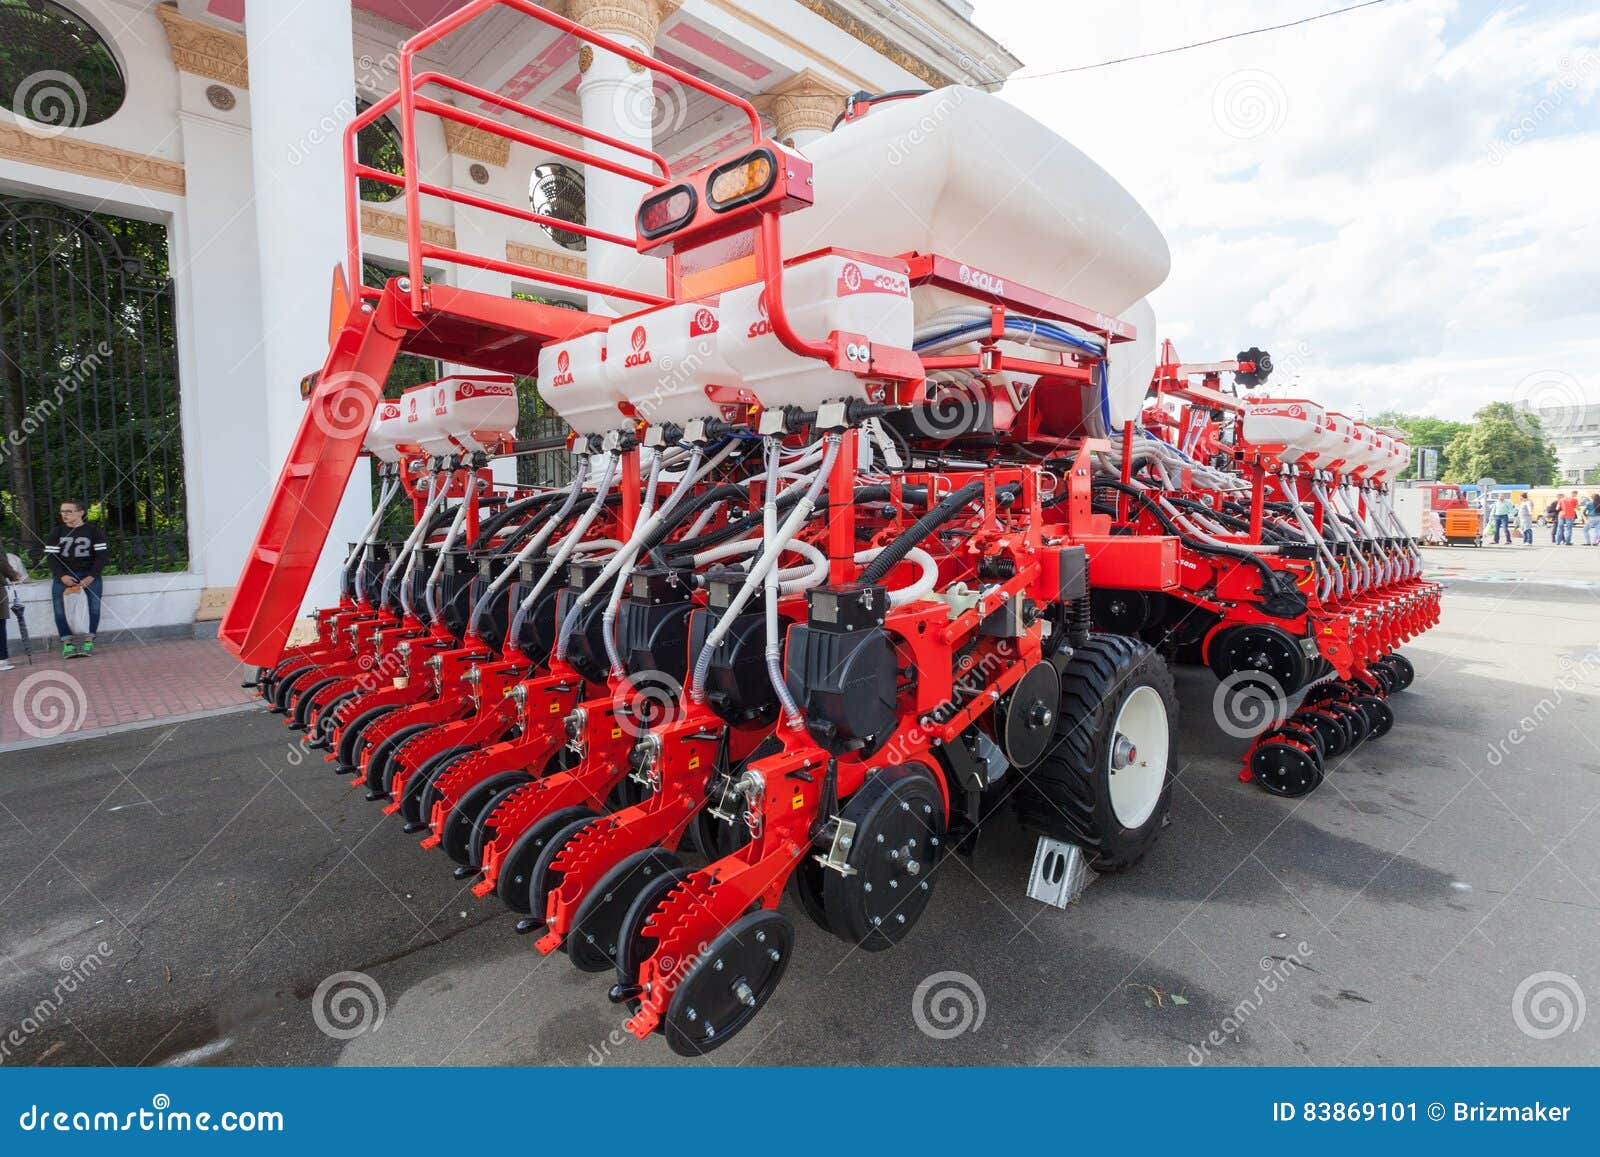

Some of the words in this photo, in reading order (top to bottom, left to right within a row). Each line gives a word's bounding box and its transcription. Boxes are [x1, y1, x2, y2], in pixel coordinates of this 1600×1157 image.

[970, 271, 1004, 296] SOLA
[625, 351, 652, 368] SOLA
[553, 373, 574, 387] SOLA
[60, 536, 91, 557] 72
